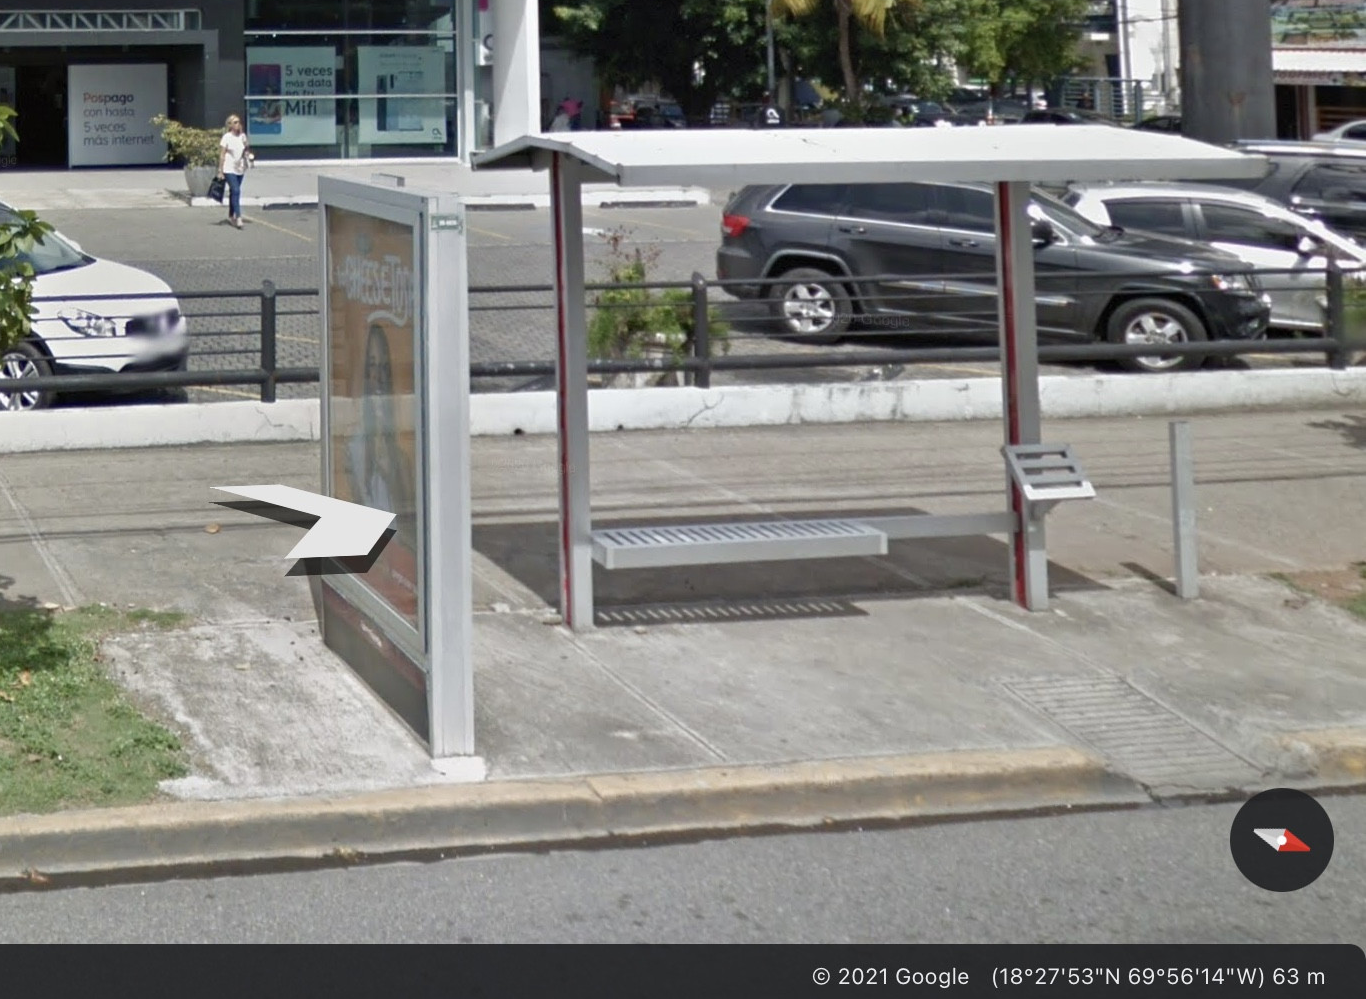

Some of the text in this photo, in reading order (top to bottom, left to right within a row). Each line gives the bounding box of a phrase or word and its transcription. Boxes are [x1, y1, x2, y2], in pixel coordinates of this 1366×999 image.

[285, 64, 334, 77] 5 veces
[83, 92, 134, 105] Pospago
[83, 106, 136, 117] con hasta
[285, 100, 318, 117] Mifi
[83, 121, 127, 133] 5 veces
[111, 134, 155, 146] internet
